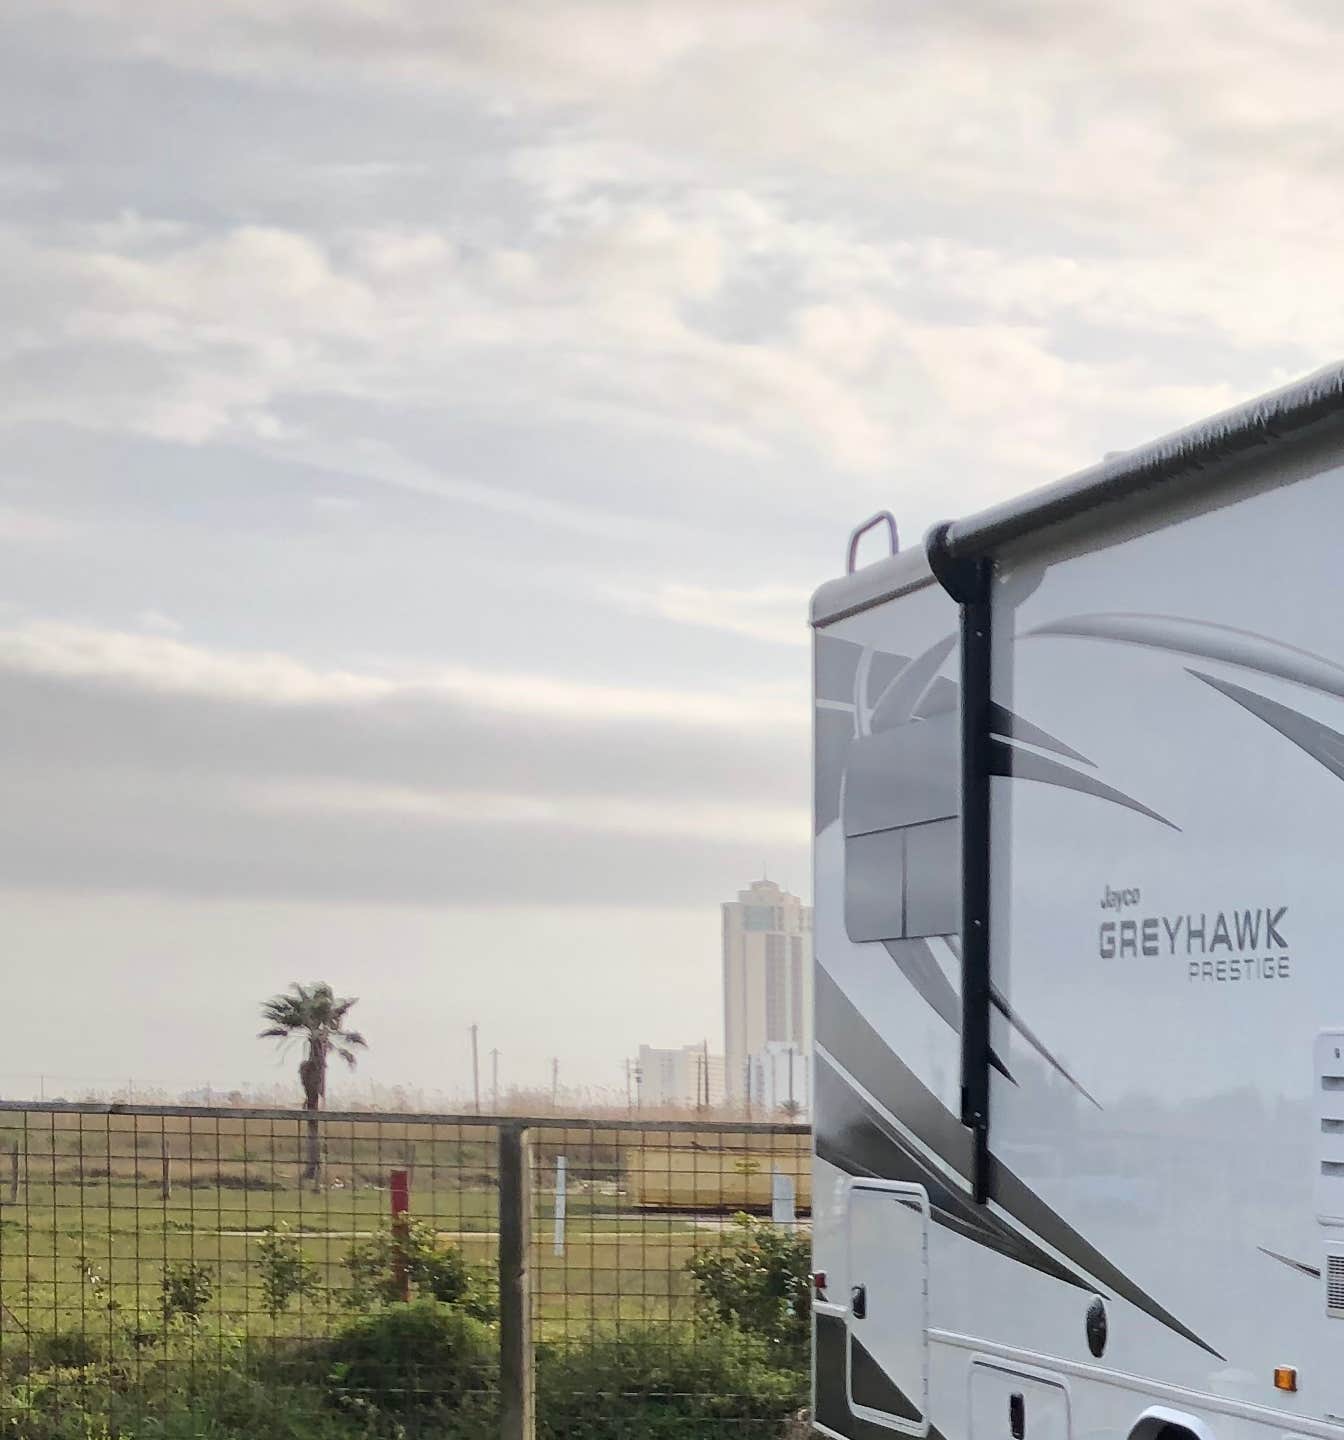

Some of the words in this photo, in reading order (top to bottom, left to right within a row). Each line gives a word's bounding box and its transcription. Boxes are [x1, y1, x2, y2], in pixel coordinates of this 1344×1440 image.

[1100, 885, 1140, 912] Jayco
[1100, 906, 1289, 959] GREYHAWK
[1189, 957, 1290, 982] PRESTIGE
